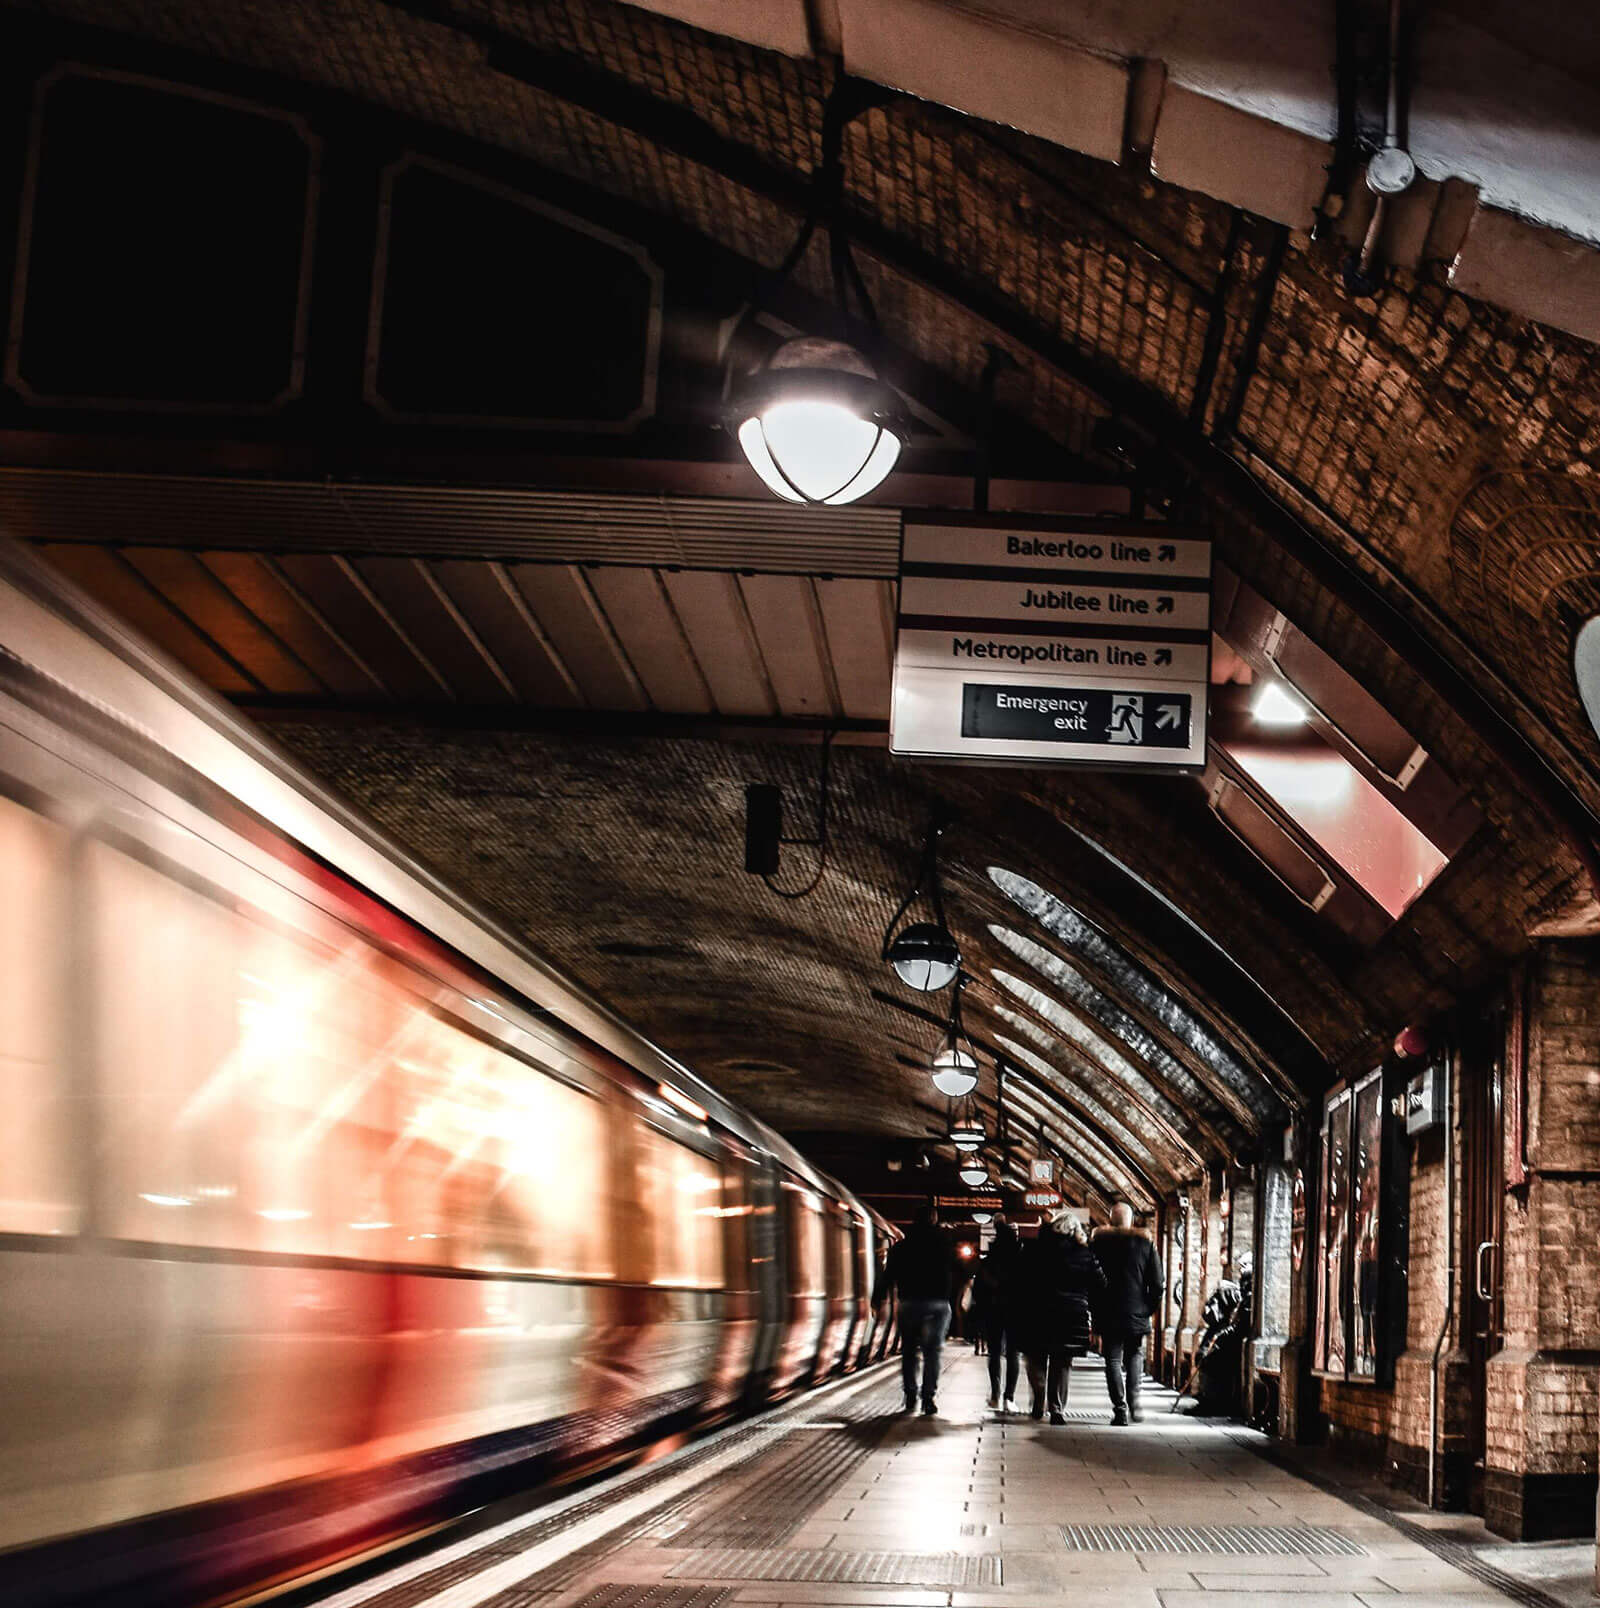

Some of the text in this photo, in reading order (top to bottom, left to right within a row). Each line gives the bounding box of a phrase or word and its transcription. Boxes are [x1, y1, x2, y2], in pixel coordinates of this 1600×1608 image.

[1006, 536, 1151, 562] Bakerloo line
[1020, 589, 1149, 613] Jubilee line
[952, 638, 1147, 665] Metropolitan line
[996, 692, 1088, 714] Emergency
[1054, 715, 1087, 731] exit
